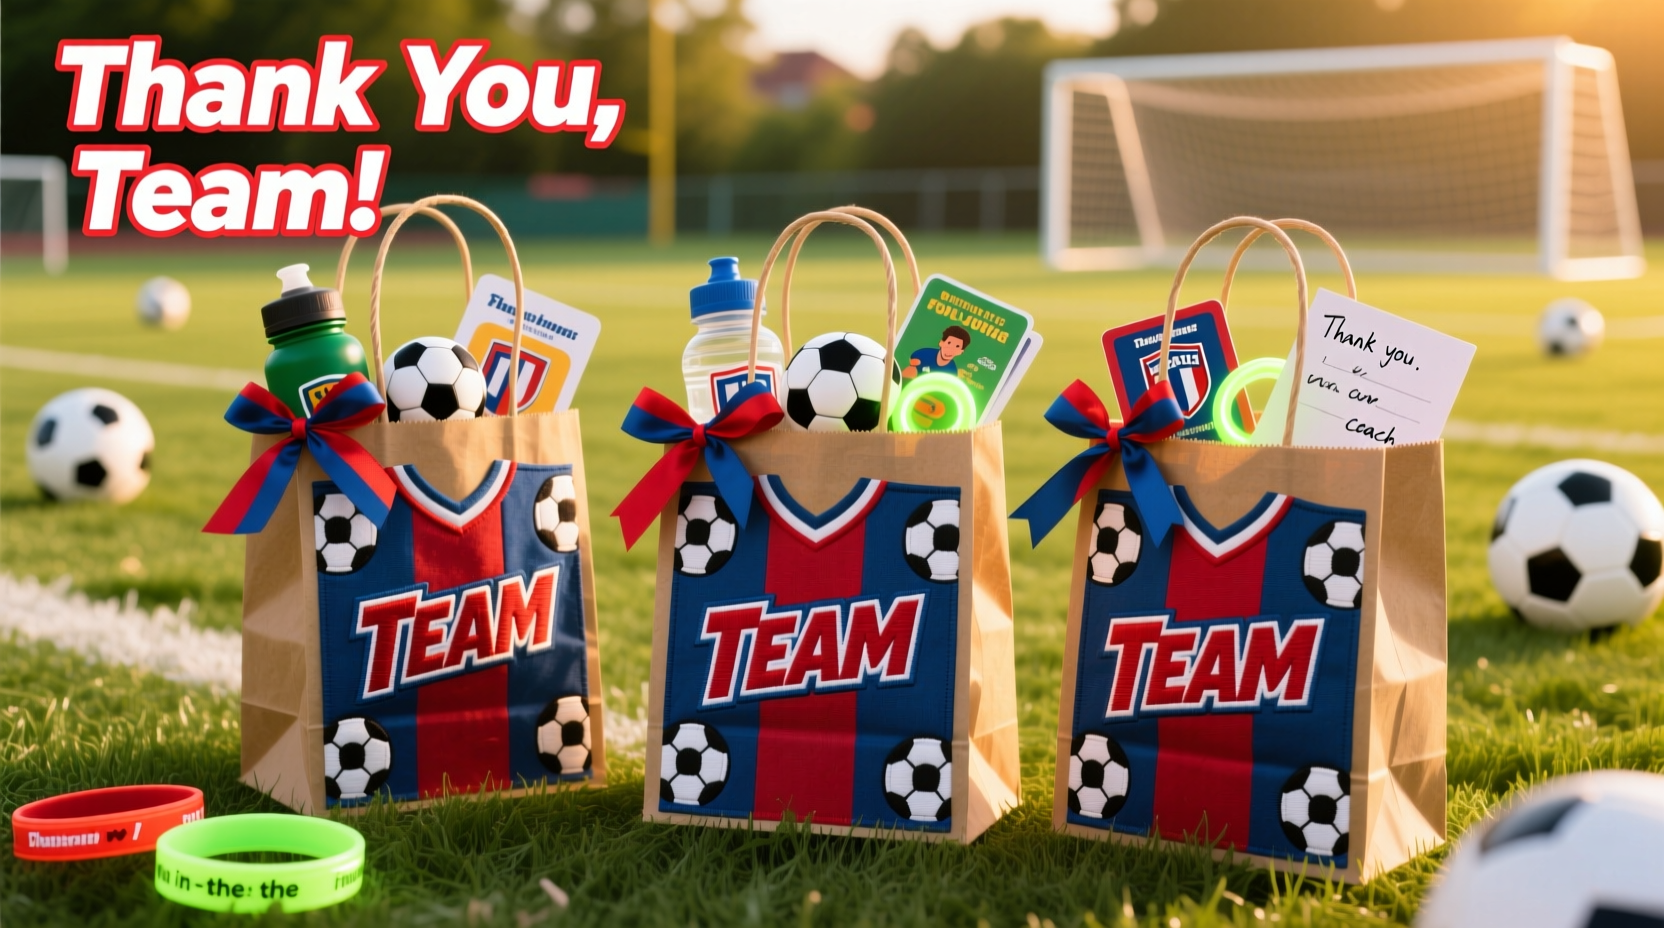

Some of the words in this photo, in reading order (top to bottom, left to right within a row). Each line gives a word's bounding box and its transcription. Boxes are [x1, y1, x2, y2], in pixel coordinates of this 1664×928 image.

[1324, 314, 1376, 353] Thank
[1379, 345, 1420, 371] you.
[356, 565, 560, 699] TEAM
[700, 593, 926, 706] TEAM
[1104, 615, 1325, 718] TEAM
[260, 879, 299, 899] the
